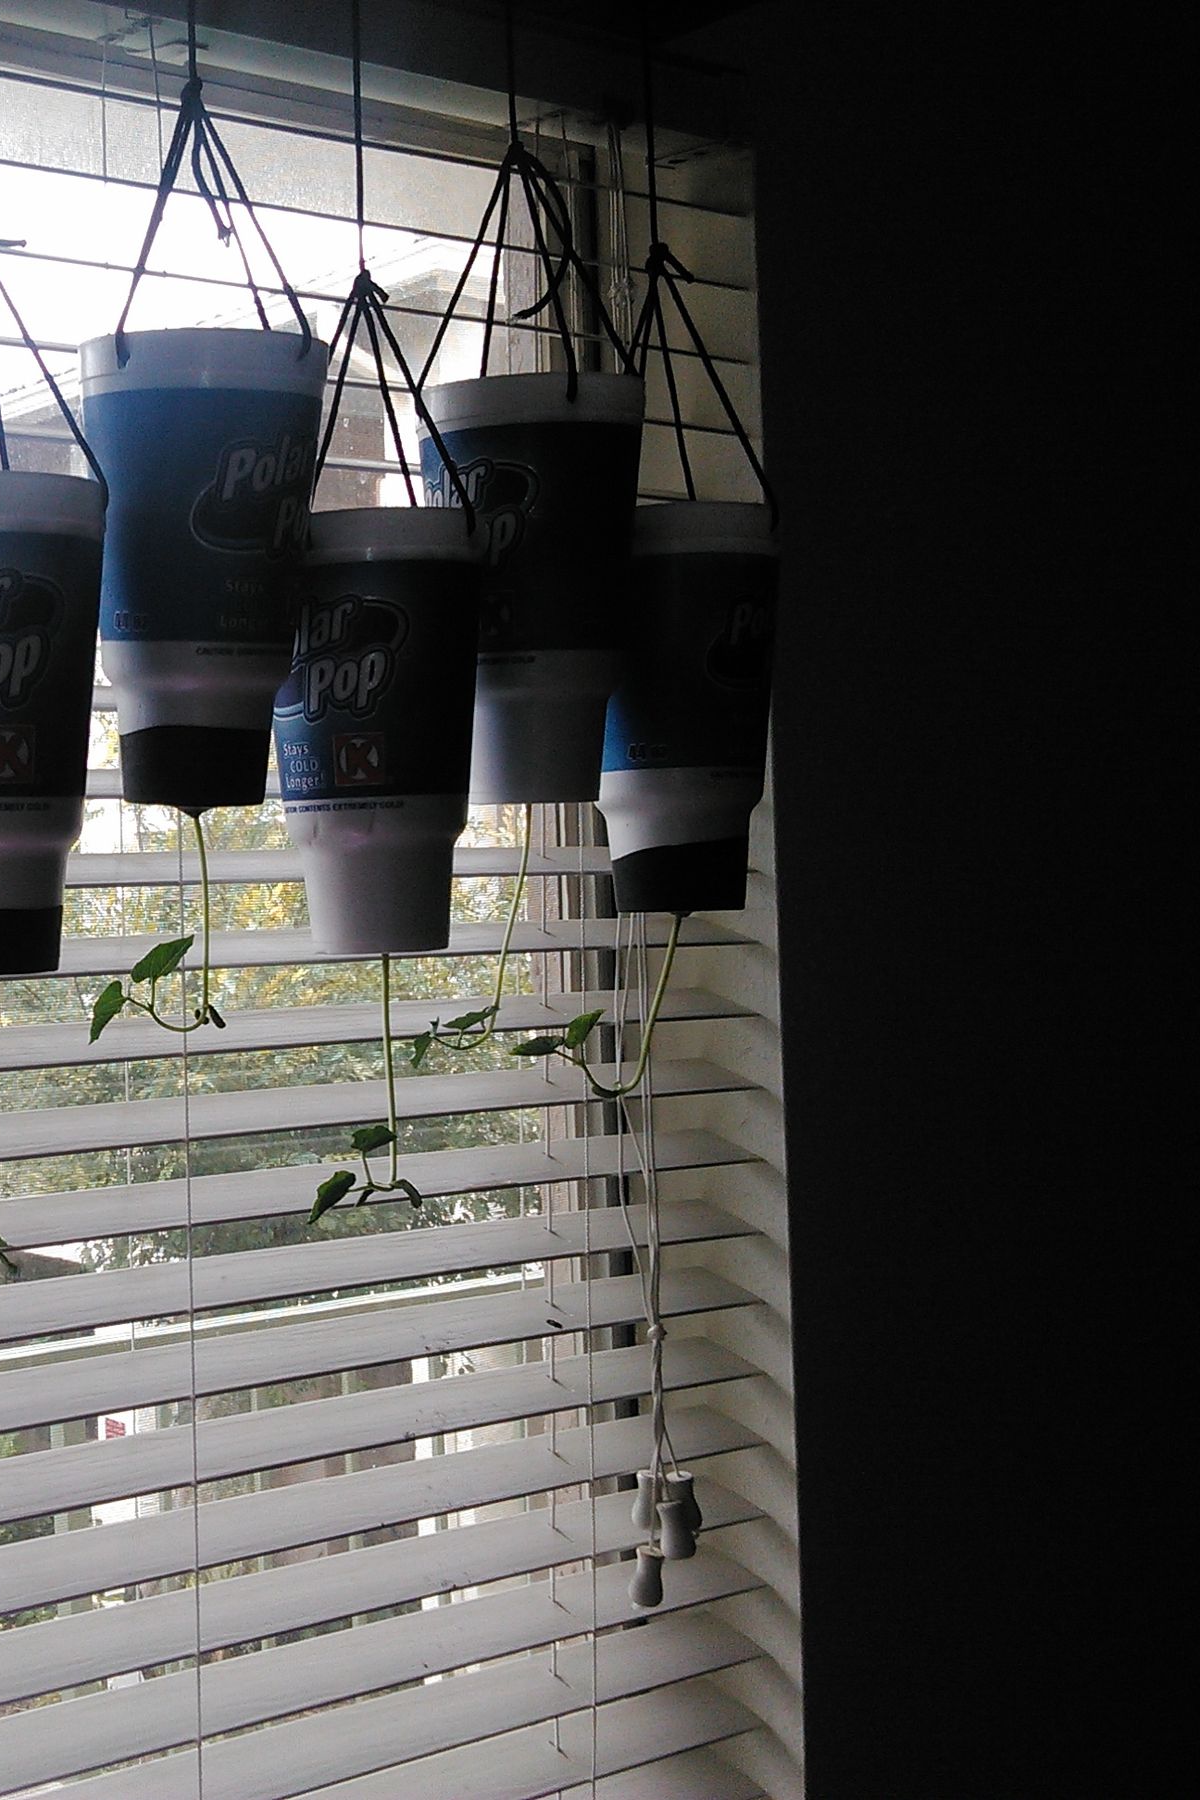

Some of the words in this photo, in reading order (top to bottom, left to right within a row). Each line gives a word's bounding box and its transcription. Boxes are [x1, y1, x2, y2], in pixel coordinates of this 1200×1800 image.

[222, 434, 307, 502] Pola
[308, 649, 388, 715] Pop
[283, 743, 309, 758] Stays
[290, 759, 319, 773] COLD
